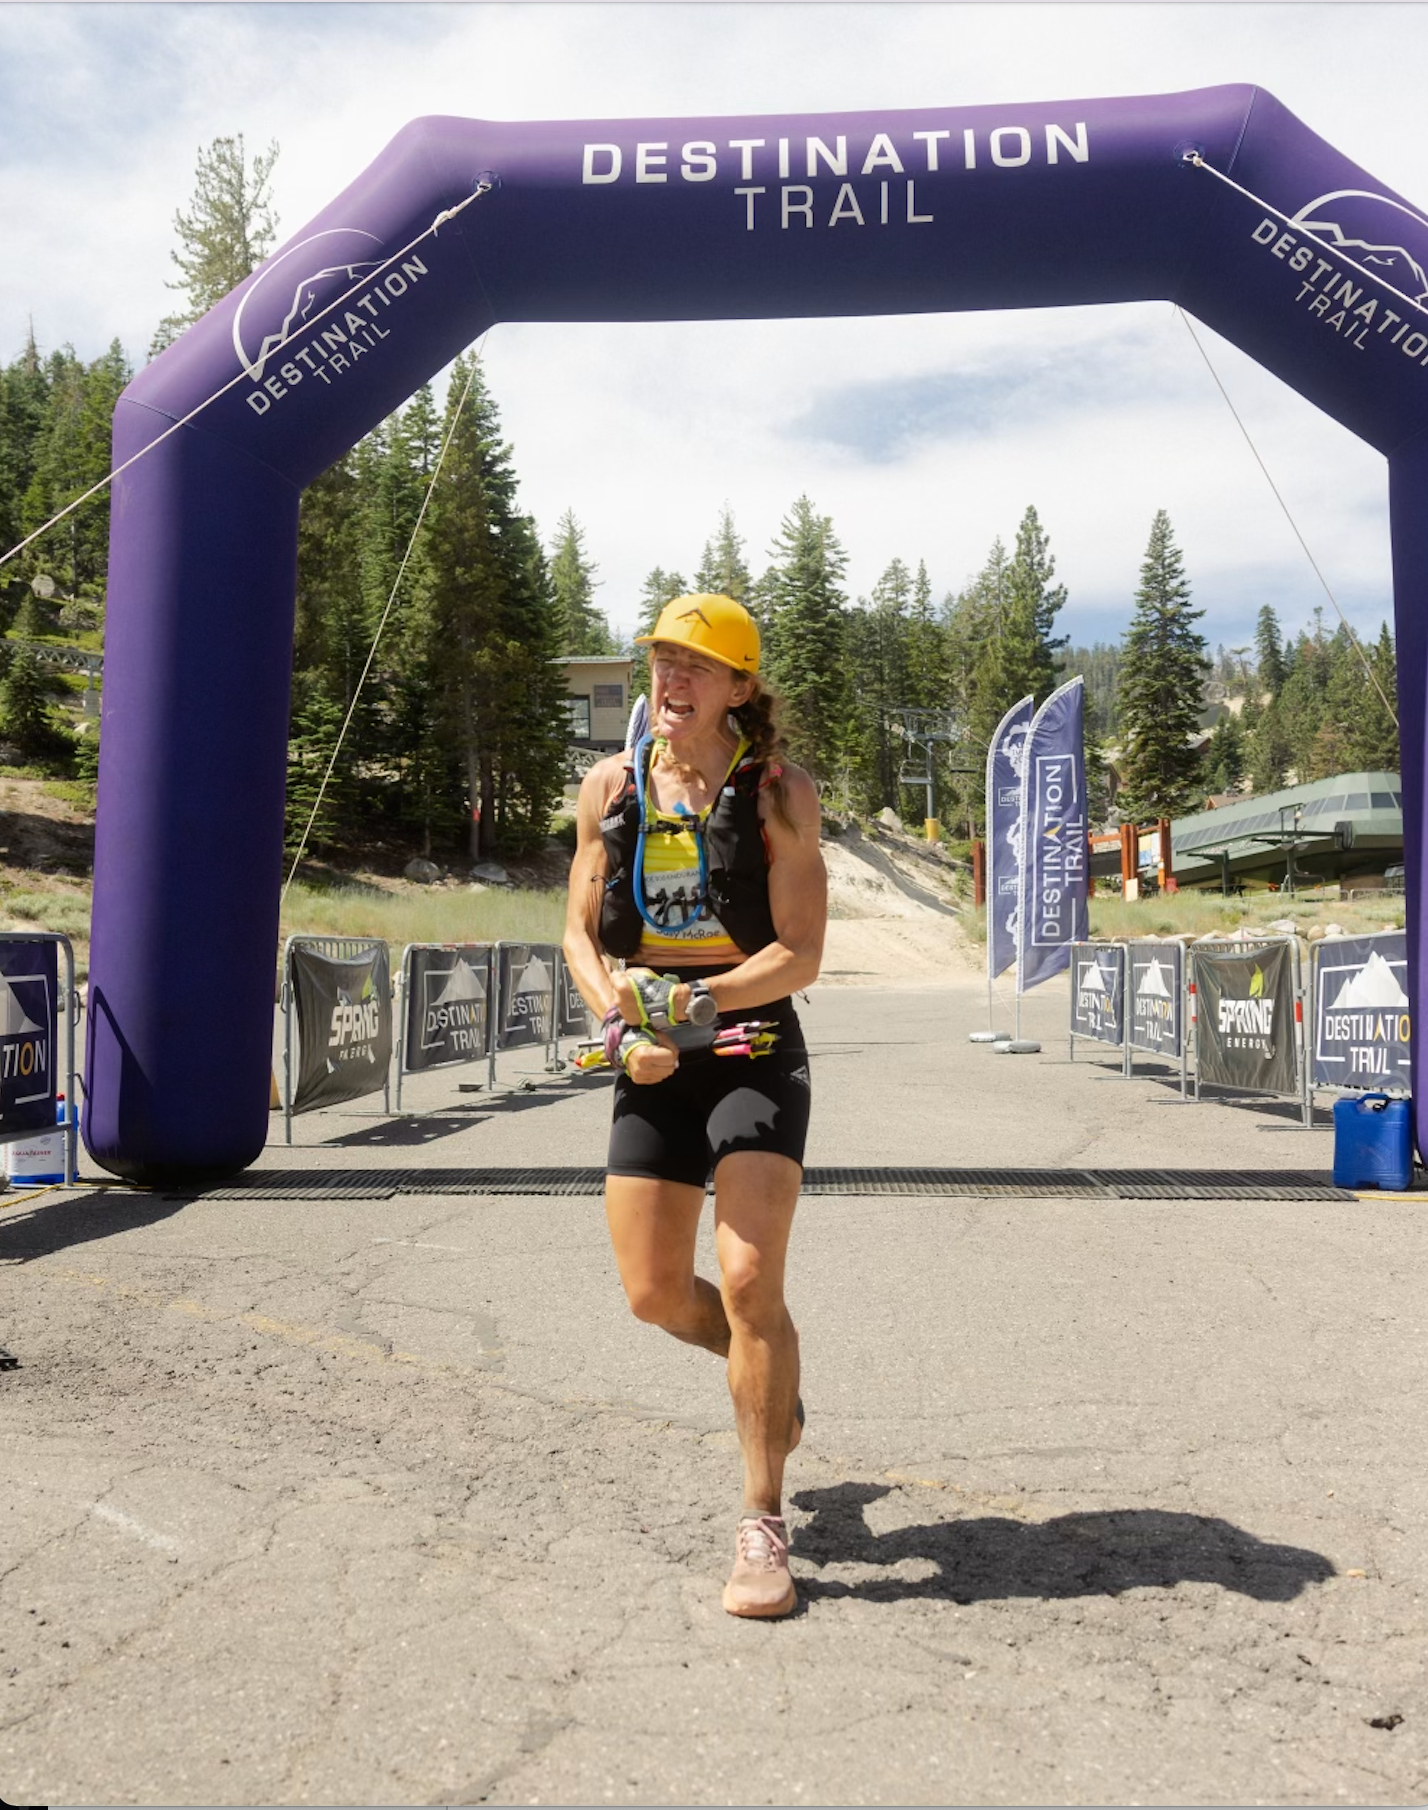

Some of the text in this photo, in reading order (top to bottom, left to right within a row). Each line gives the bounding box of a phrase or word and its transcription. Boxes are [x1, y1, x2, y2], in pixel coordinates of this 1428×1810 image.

[582, 122, 1090, 184] DESTINATION
[734, 180, 934, 231] TRAIL
[1250, 217, 1428, 367] DESTINATIO
[1295, 280, 1370, 350] TRAIL
[245, 254, 429, 416] DESTINATION
[312, 322, 391, 385] TRAIL
[1041, 763, 1063, 938] DESTINATION
[1064, 813, 1084, 887] TRAIL
[1218, 998, 1274, 1034] SPRING
[1325, 1012, 1411, 1042] DESTINATIO
